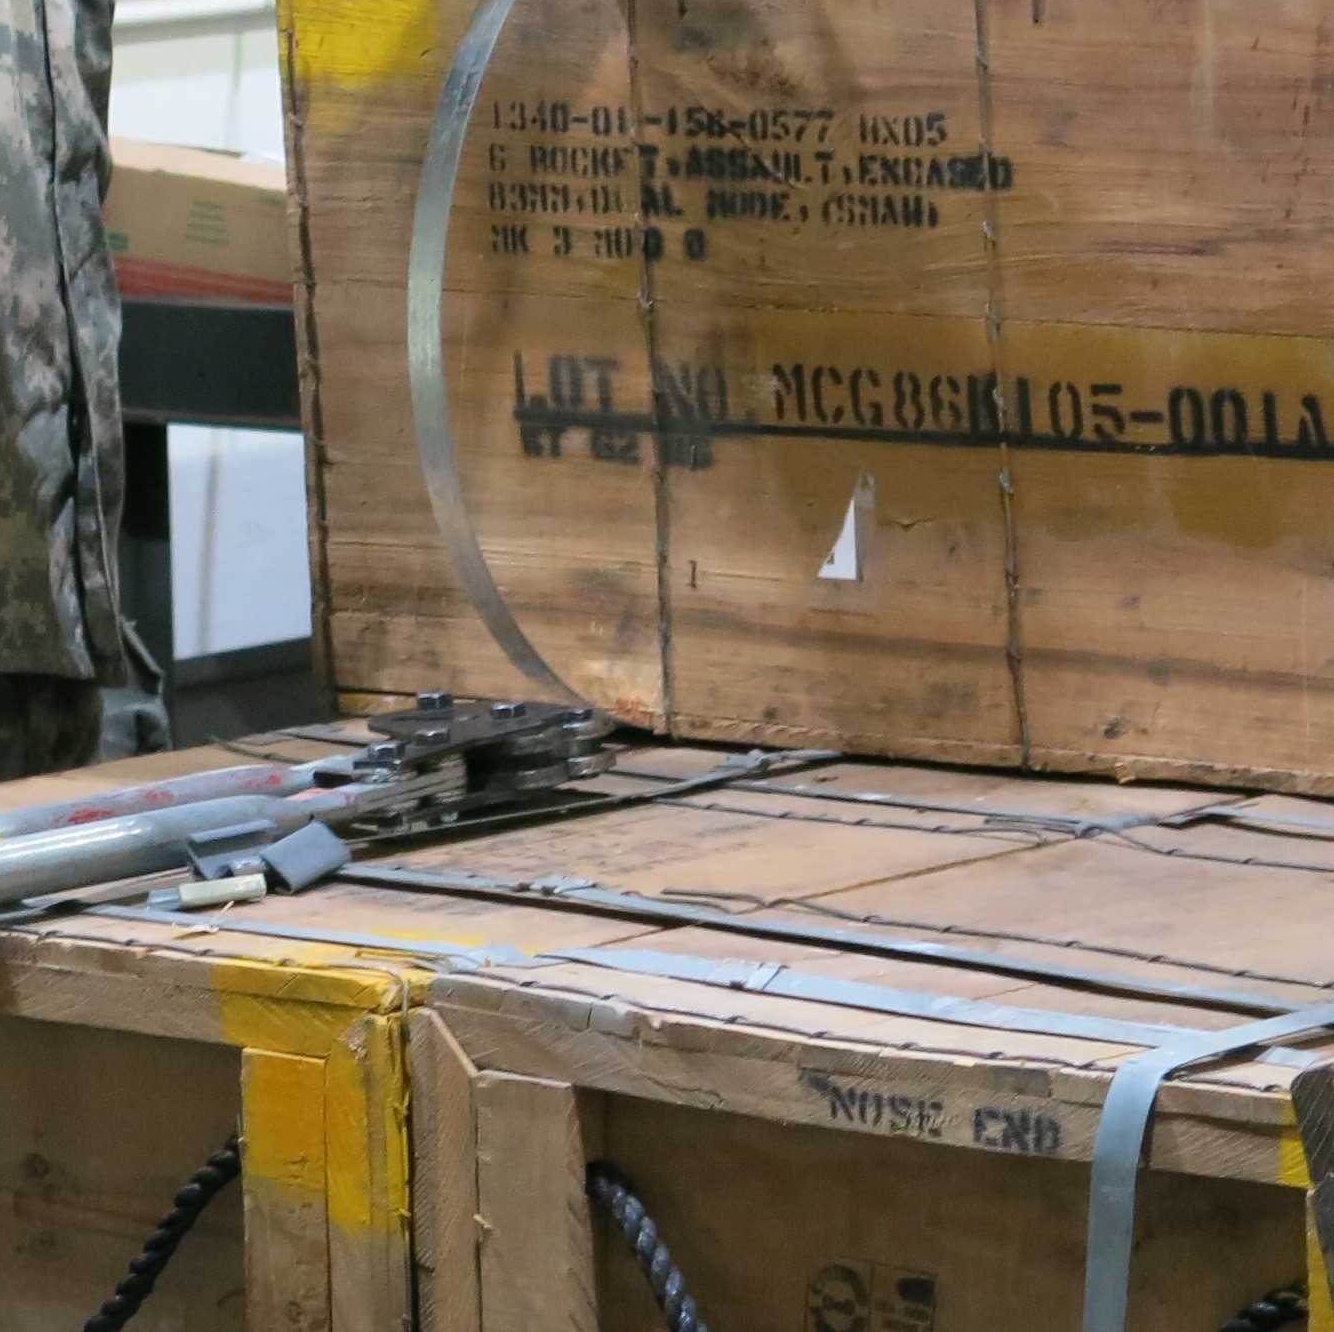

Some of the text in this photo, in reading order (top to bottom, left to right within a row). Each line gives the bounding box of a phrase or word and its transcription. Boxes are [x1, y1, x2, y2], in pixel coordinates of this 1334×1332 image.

[513, 350, 621, 414] LOT
[828, 1082, 1062, 1155] NOSE END
